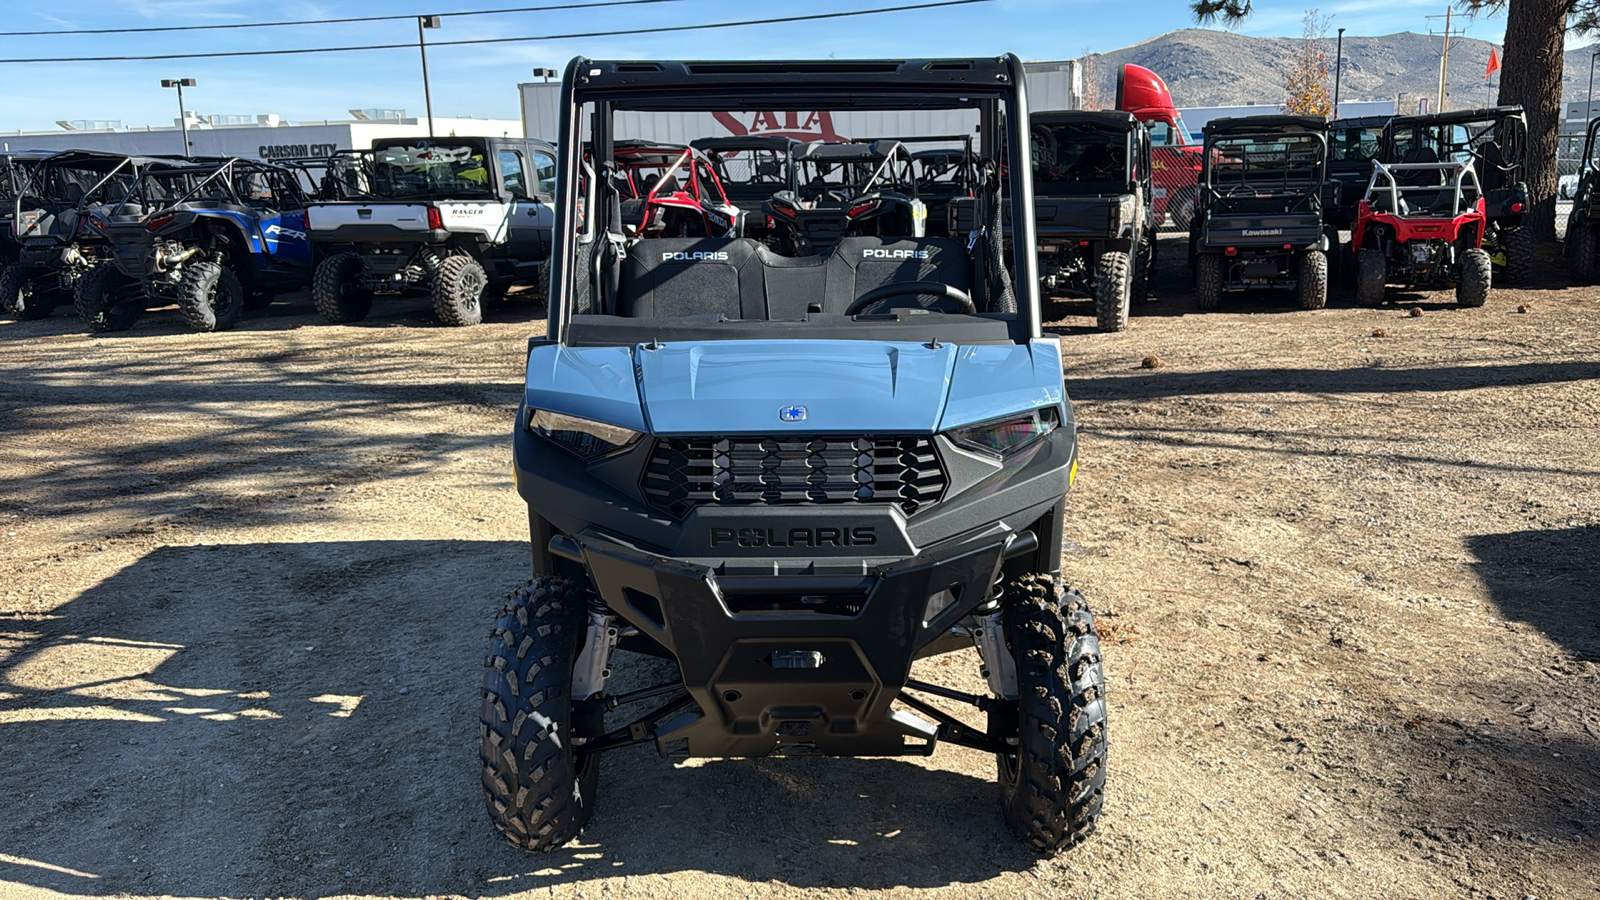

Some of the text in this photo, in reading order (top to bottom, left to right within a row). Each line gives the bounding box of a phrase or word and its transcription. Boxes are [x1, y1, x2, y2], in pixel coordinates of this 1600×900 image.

[259, 143, 337, 158] CARSON CITY
[265, 224, 307, 241] RZR
[1241, 228, 1283, 236] Kawasaki
[662, 251, 728, 262] POLARIS
[863, 249, 929, 259] POLARIS
[710, 526, 877, 548] POLARIS
